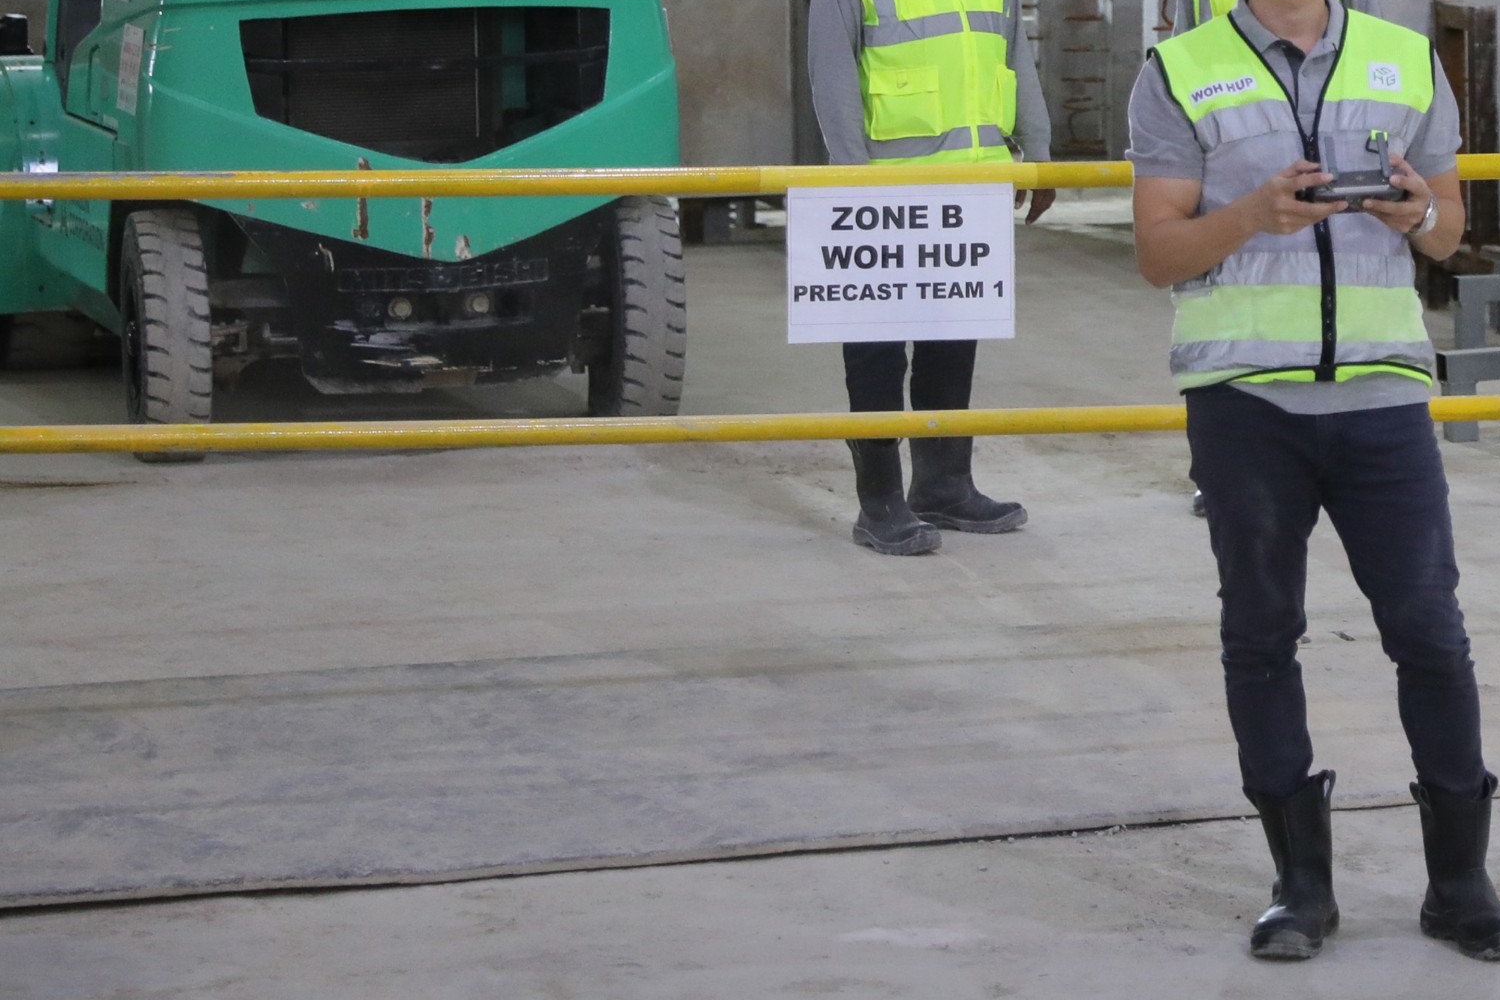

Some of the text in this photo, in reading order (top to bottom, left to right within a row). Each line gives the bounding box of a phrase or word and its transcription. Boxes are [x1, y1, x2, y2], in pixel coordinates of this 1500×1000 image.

[1191, 77, 1253, 103] WOH HUP
[831, 204, 964, 231] ZONE B
[821, 242, 990, 270] WOH HUP
[793, 280, 1004, 302] PRECAST TEAM 1
